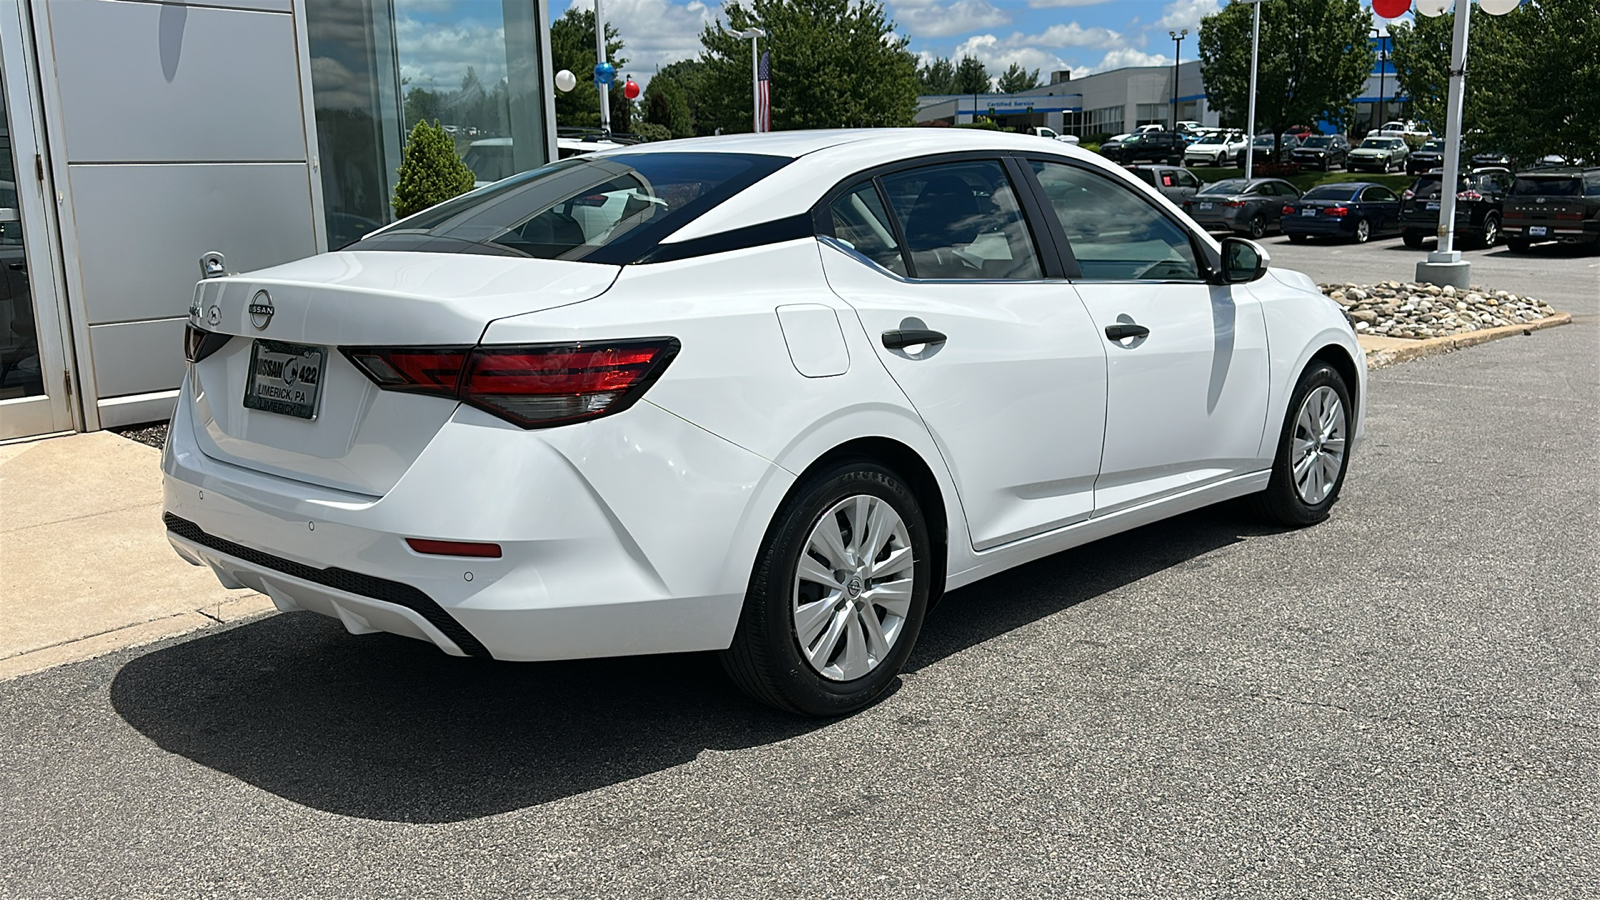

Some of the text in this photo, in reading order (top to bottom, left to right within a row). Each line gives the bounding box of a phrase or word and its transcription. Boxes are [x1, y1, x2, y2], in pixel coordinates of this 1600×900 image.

[250, 304, 273, 315] SSAN
[299, 365, 317, 385] 422
[258, 383, 306, 403] LIMERICK, PA
